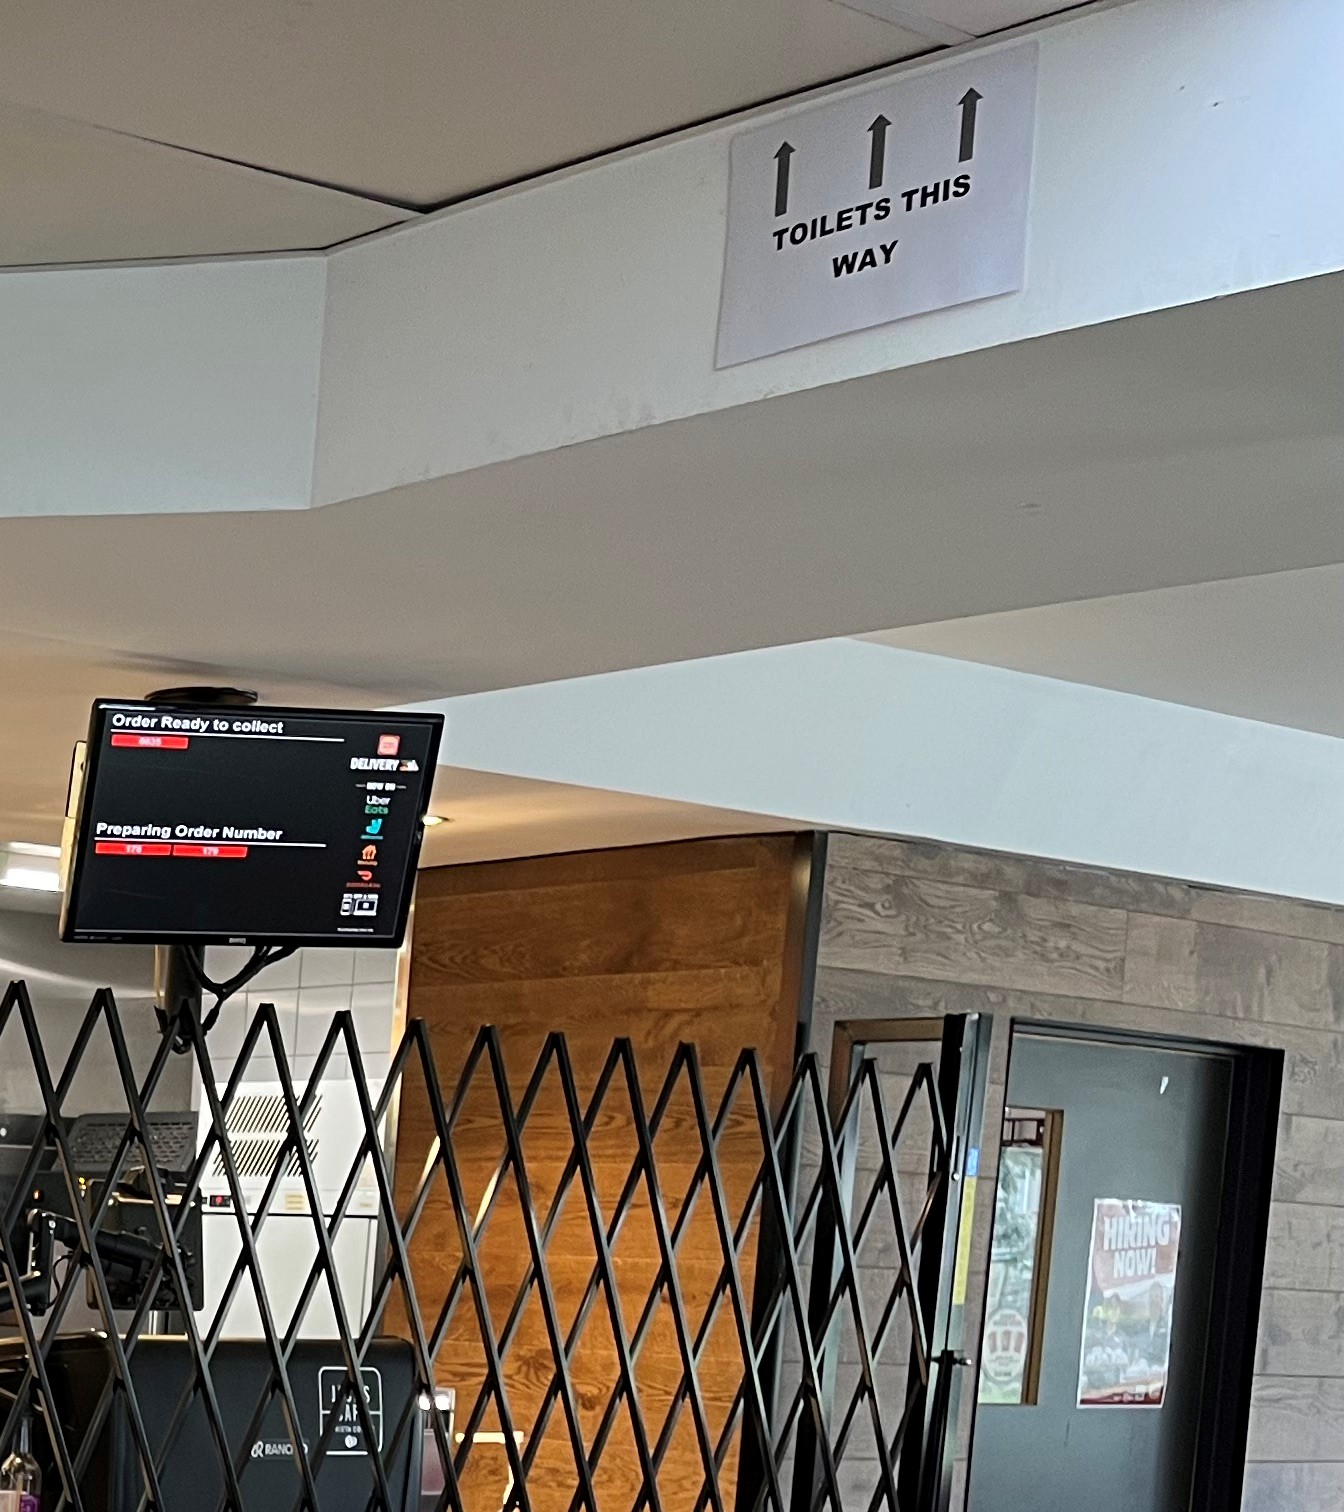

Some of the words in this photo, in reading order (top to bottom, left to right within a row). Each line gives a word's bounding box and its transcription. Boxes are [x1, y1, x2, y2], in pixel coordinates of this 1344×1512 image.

[772, 198, 891, 251] TOILETS
[900, 174, 971, 212] THIS
[831, 240, 898, 278] WAY
[112, 713, 159, 728] Order
[161, 716, 210, 732] Ready
[213, 719, 229, 732] to
[232, 720, 284, 734] collect
[350, 757, 400, 772] DELIVERY
[96, 822, 171, 839] Preparing
[175, 824, 219, 839] Order
[222, 826, 283, 840] Number
[1102, 1212, 1170, 1251] HIRING
[1113, 1247, 1157, 1279] NOW!
